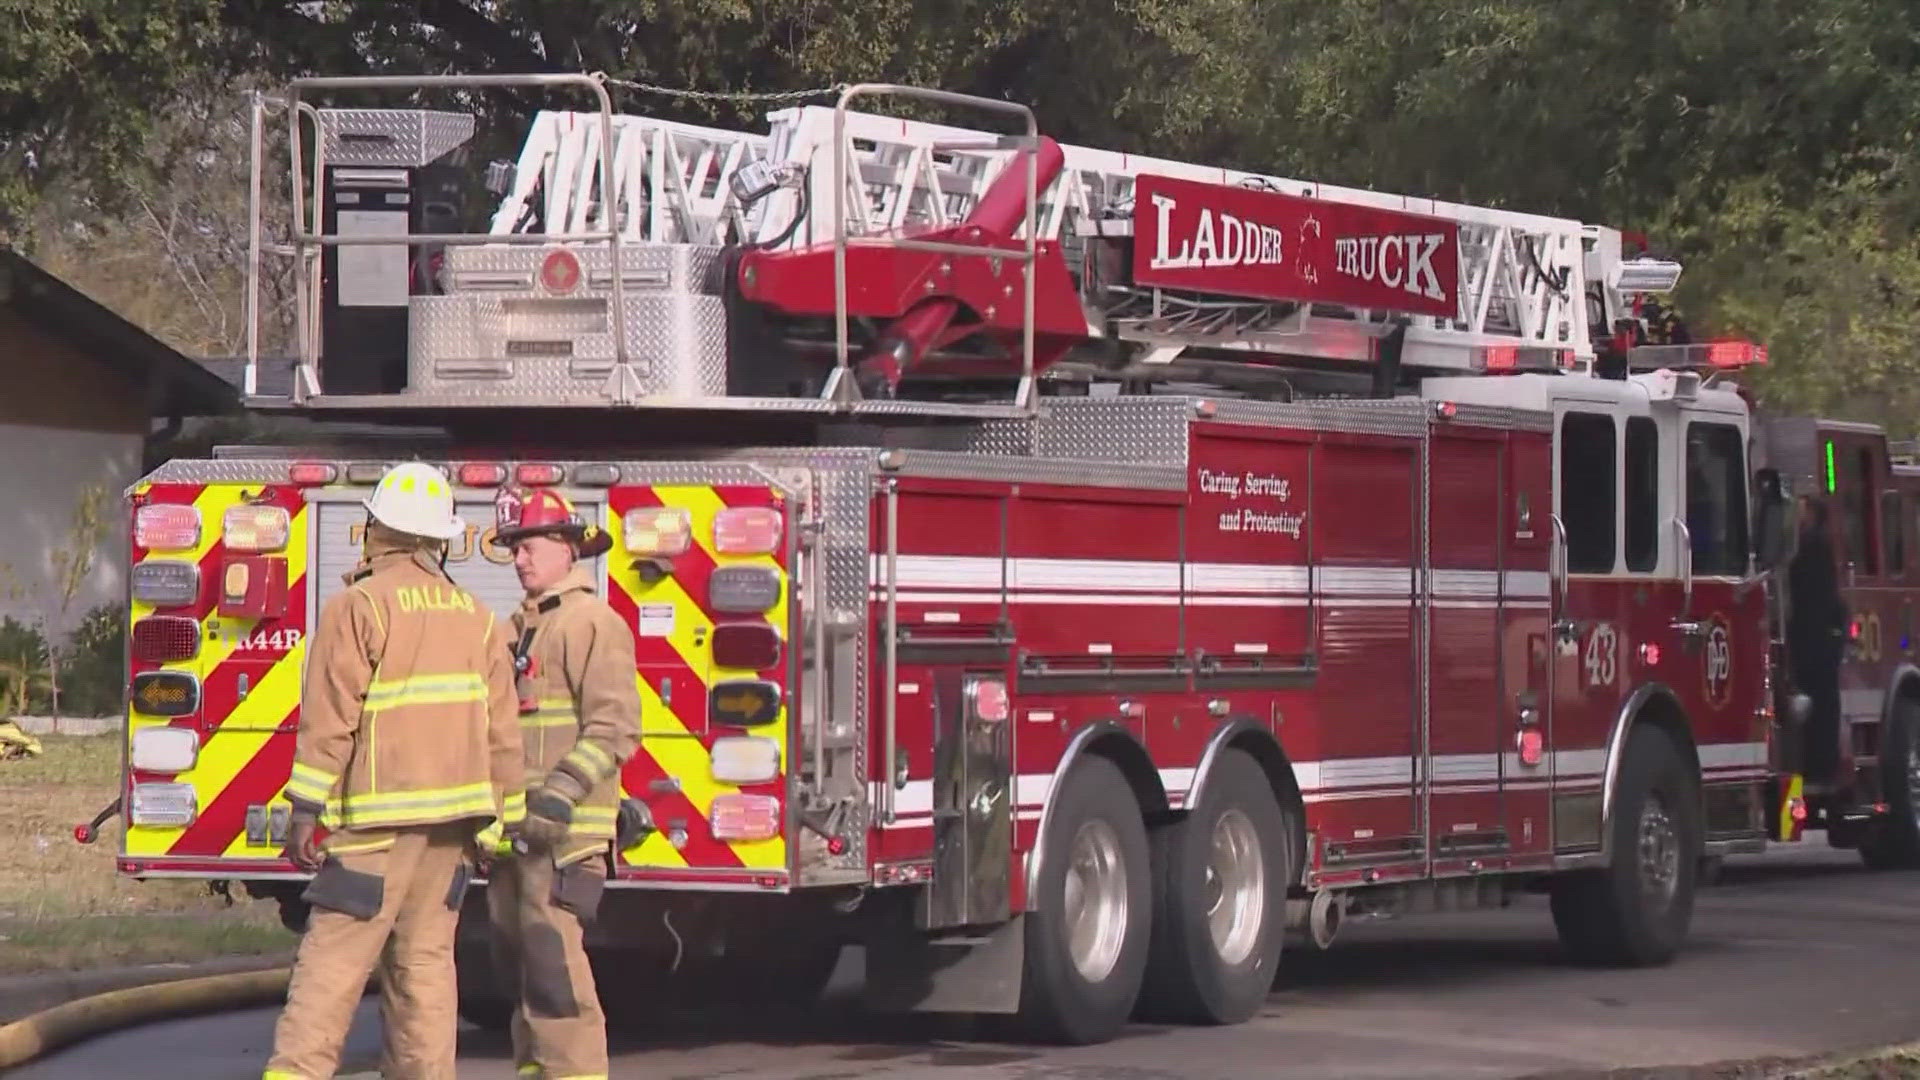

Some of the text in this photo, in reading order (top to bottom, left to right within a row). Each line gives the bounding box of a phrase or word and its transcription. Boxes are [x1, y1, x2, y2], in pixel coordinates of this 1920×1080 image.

[1151, 193, 1446, 302] LADDER TRUCK
[1219, 508, 1240, 531] and
[1585, 623, 1617, 686] 43
